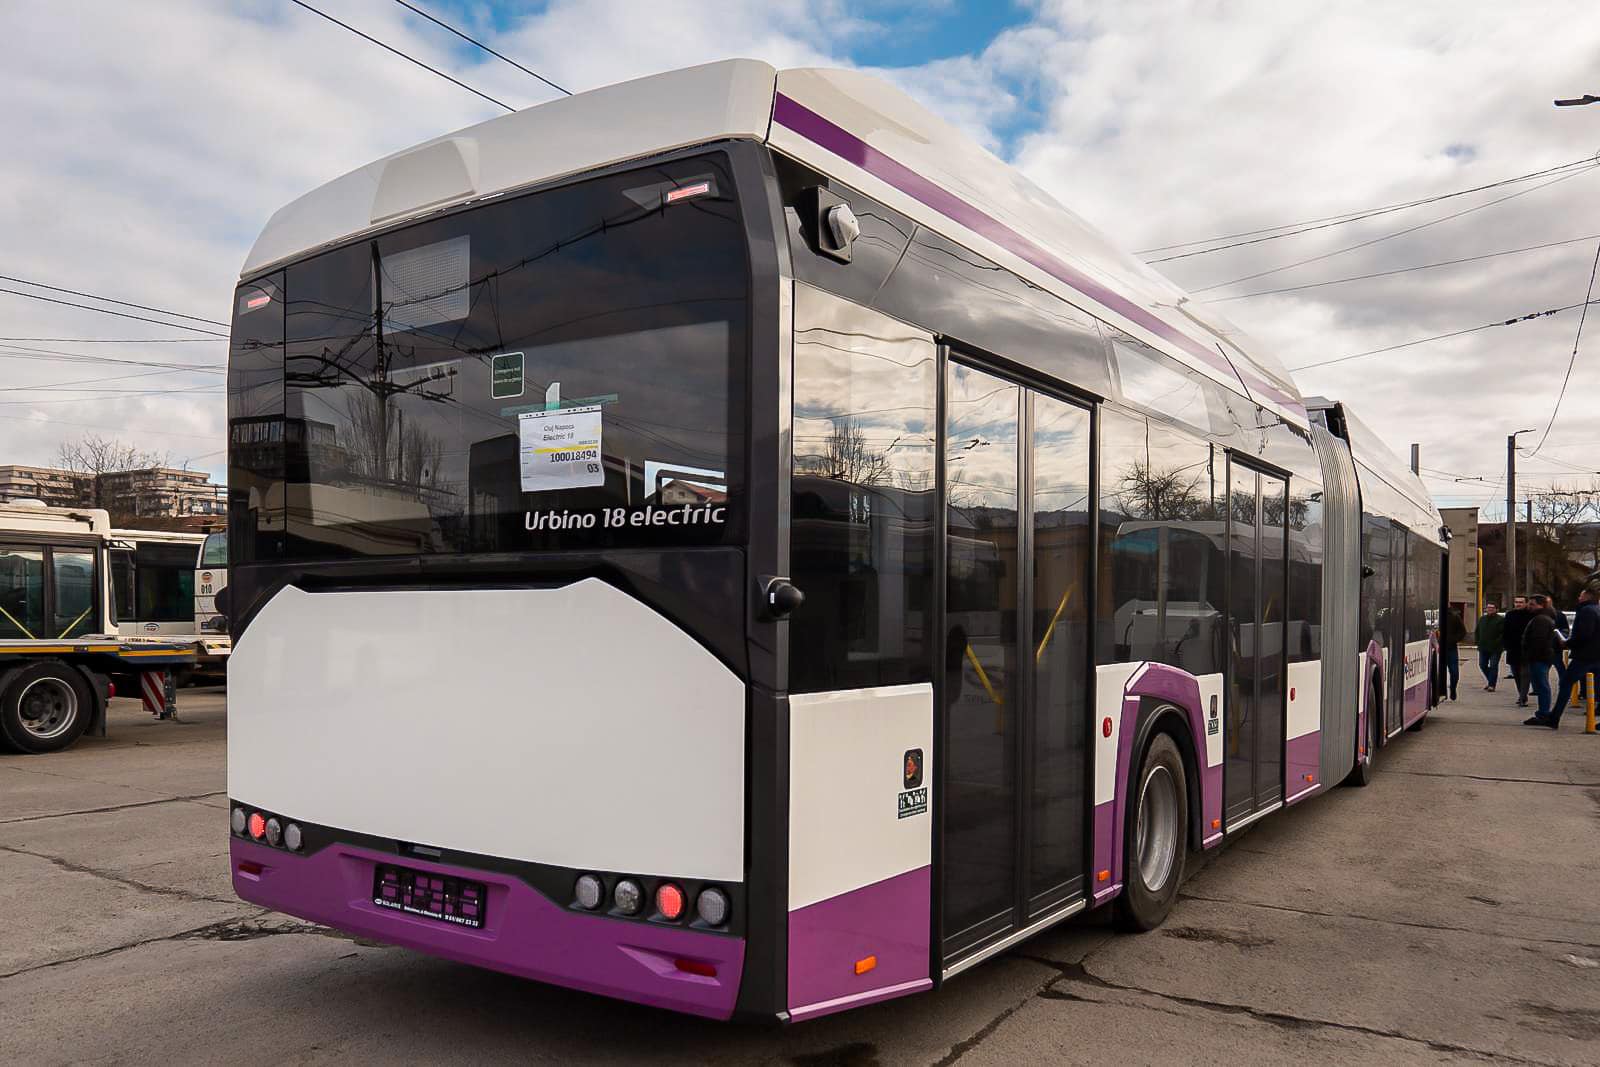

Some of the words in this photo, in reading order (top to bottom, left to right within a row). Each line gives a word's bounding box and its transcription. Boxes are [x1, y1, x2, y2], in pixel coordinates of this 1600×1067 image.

[543, 433, 566, 441] Electric
[550, 450, 597, 463] 100018494
[587, 463, 600, 474] 03
[525, 510, 596, 530] Urbino
[602, 507, 626, 528] 18
[630, 503, 726, 527] electric
